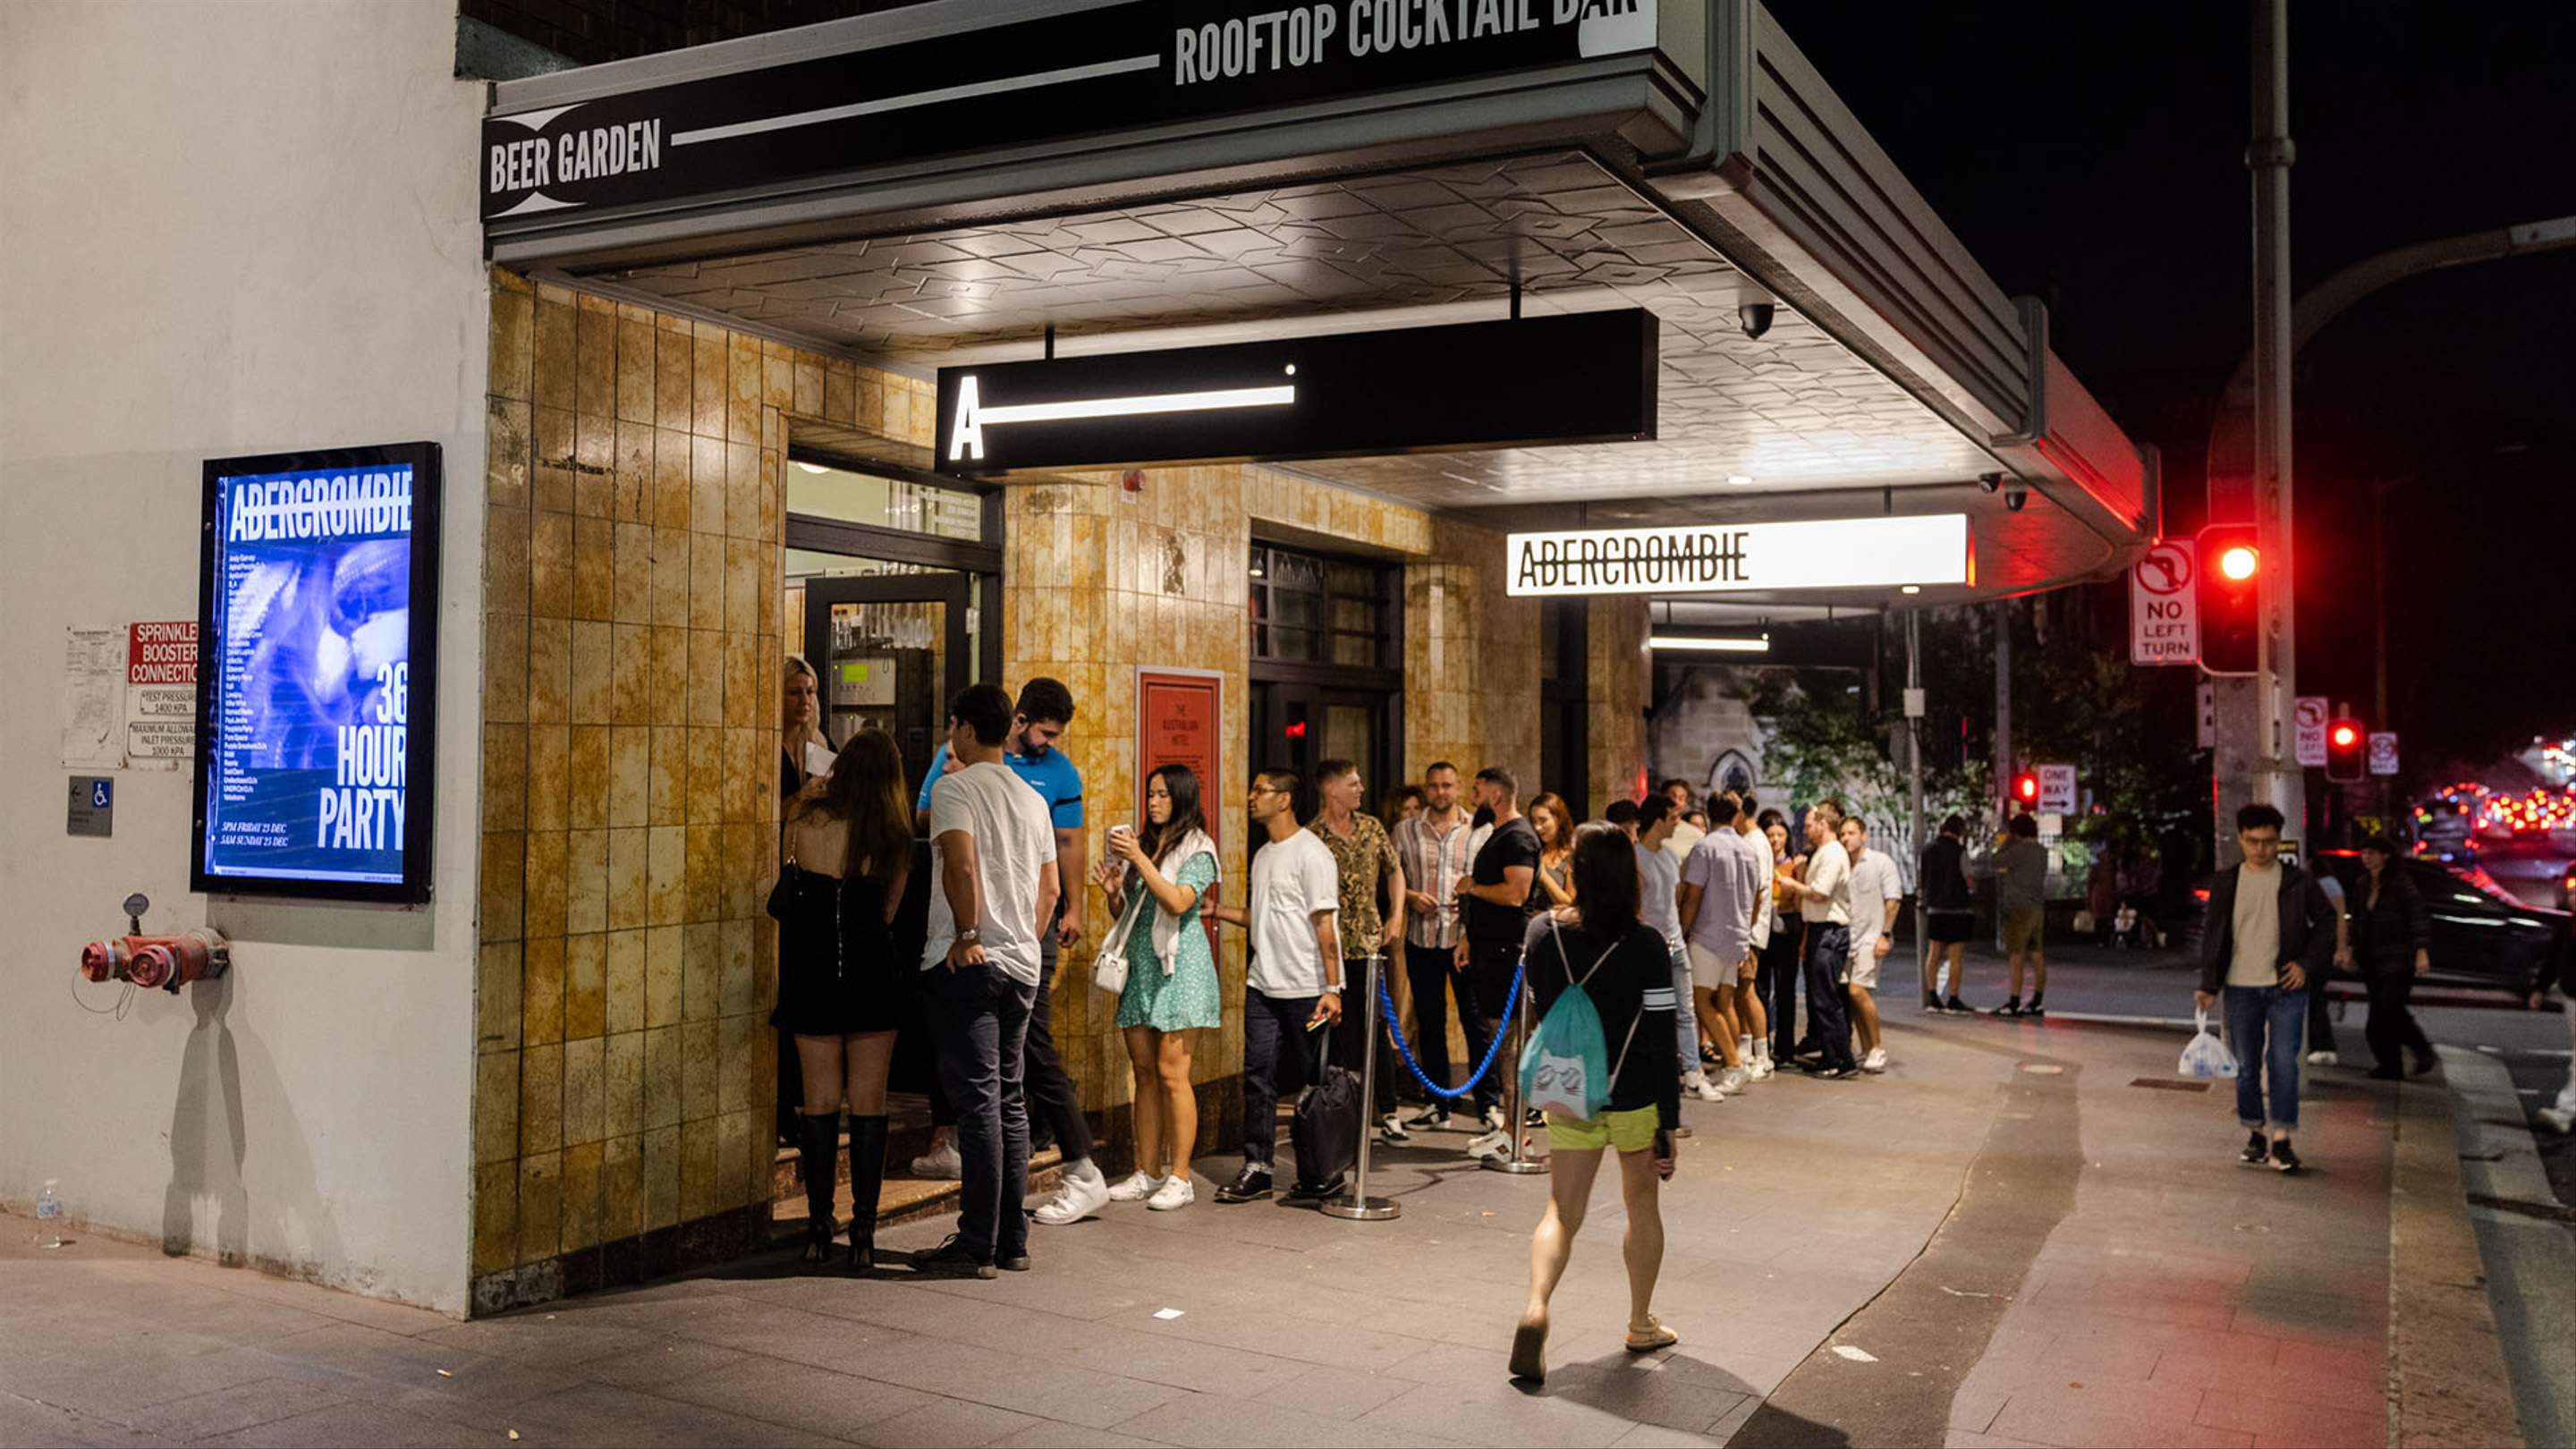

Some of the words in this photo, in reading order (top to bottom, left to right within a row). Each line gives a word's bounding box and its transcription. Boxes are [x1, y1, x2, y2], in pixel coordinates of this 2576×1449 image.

[1175, 4, 1336, 86] ROOFTOP
[490, 138, 551, 194] BEER
[557, 118, 661, 183] GARDEN
[229, 470, 412, 542] ABERCROMBIE
[1518, 532, 1750, 588] ABERCROMBIE
[2148, 601, 2182, 620] NO
[137, 623, 198, 643] SPRINKLE
[2144, 624, 2188, 638] LEFT
[143, 643, 198, 663] BOOSTER
[2142, 642, 2190, 655] TURN
[131, 663, 198, 682] CONNECTIO
[377, 661, 408, 724] 36
[337, 724, 407, 787] HOUR
[2045, 769, 2067, 780] ONE
[2045, 784, 2069, 794] WAY
[271, 823, 287, 834] DEC
[318, 787, 405, 851] PARTY
[272, 836, 289, 847] DEC
